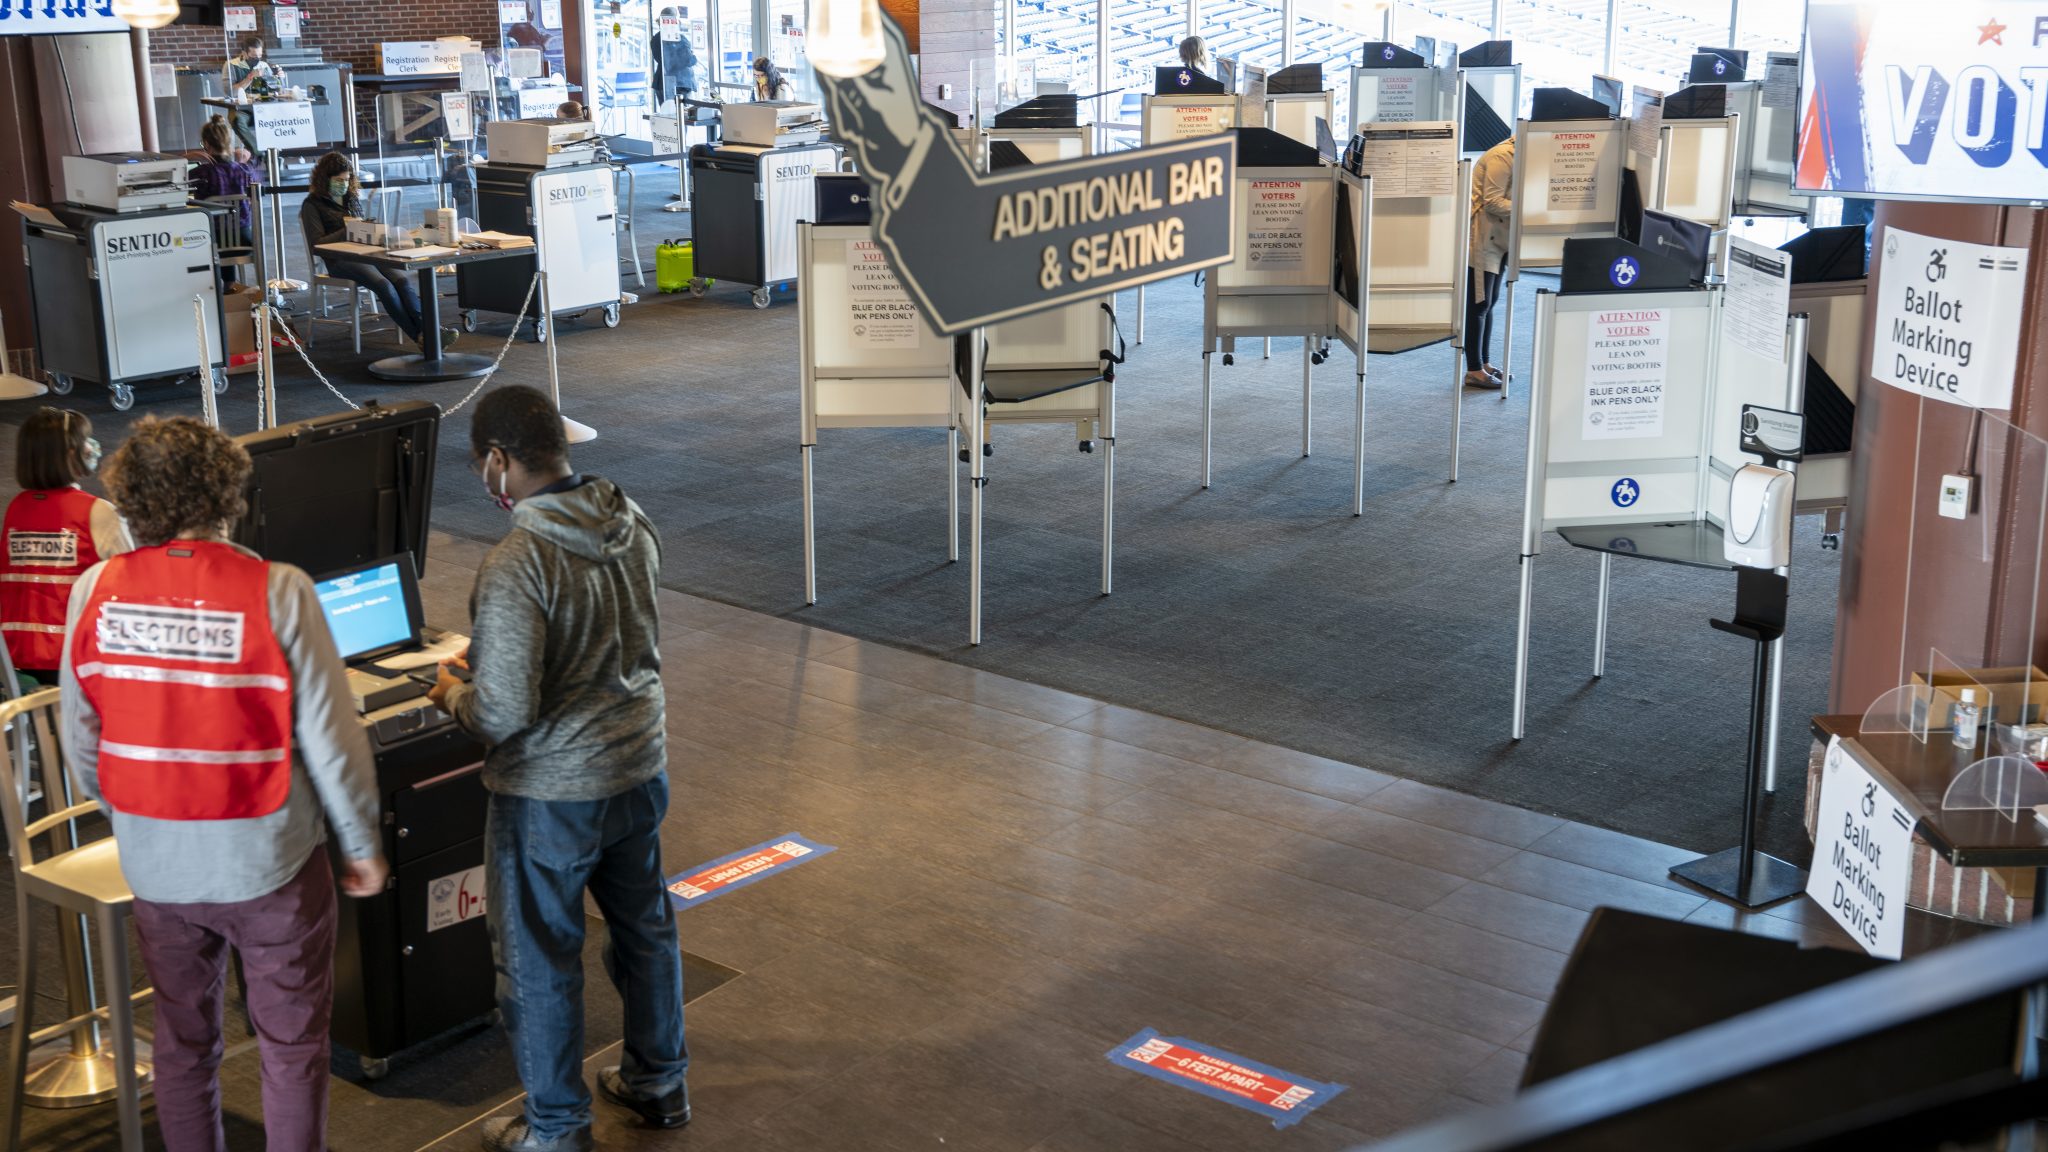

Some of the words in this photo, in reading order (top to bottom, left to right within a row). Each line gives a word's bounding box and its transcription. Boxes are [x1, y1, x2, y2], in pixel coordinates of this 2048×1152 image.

[386, 56, 430, 65] Registration
[434, 55, 460, 64] Registr
[258, 117, 310, 129] Registration
[274, 128, 297, 137] Clerk
[776, 165, 810, 178] SENTIO
[549, 186, 586, 201] SENTIO
[993, 169, 1162, 242] ADDITIONAL
[1169, 156, 1224, 206] BAR
[107, 232, 171, 254] SENTIO
[1040, 245, 1063, 290] &
[1070, 217, 1184, 282] SEATING
[1904, 286, 1963, 323] Ballot
[1599, 311, 1661, 322] ATTENTION
[1607, 326, 1650, 336] VOTERS
[1595, 339, 1628, 348] PLEASE
[1892, 317, 1972, 367] Marking
[1592, 363, 1625, 371] VOTING
[1626, 362, 1661, 370] BOOTHS
[1895, 352, 1959, 393] Device
[1589, 388, 1613, 396] BLUE
[1631, 385, 1662, 394] BLACK
[1591, 398, 1606, 406] INK
[1608, 397, 1632, 405] PENS
[11, 541, 73, 553] ELECTIONS
[107, 619, 235, 647] ELECTIONS
[1844, 811, 1882, 870] Ballot
[708, 867, 742, 883] APART
[1832, 840, 1885, 920] Marking
[1833, 880, 1878, 946] Device
[1177, 1057, 1188, 1067] 6
[1187, 1060, 1223, 1077] FEET
[1218, 1070, 1265, 1091] APART
[1199, 1054, 1231, 1070] PLEASE
[1231, 1062, 1264, 1079] REMAIN
